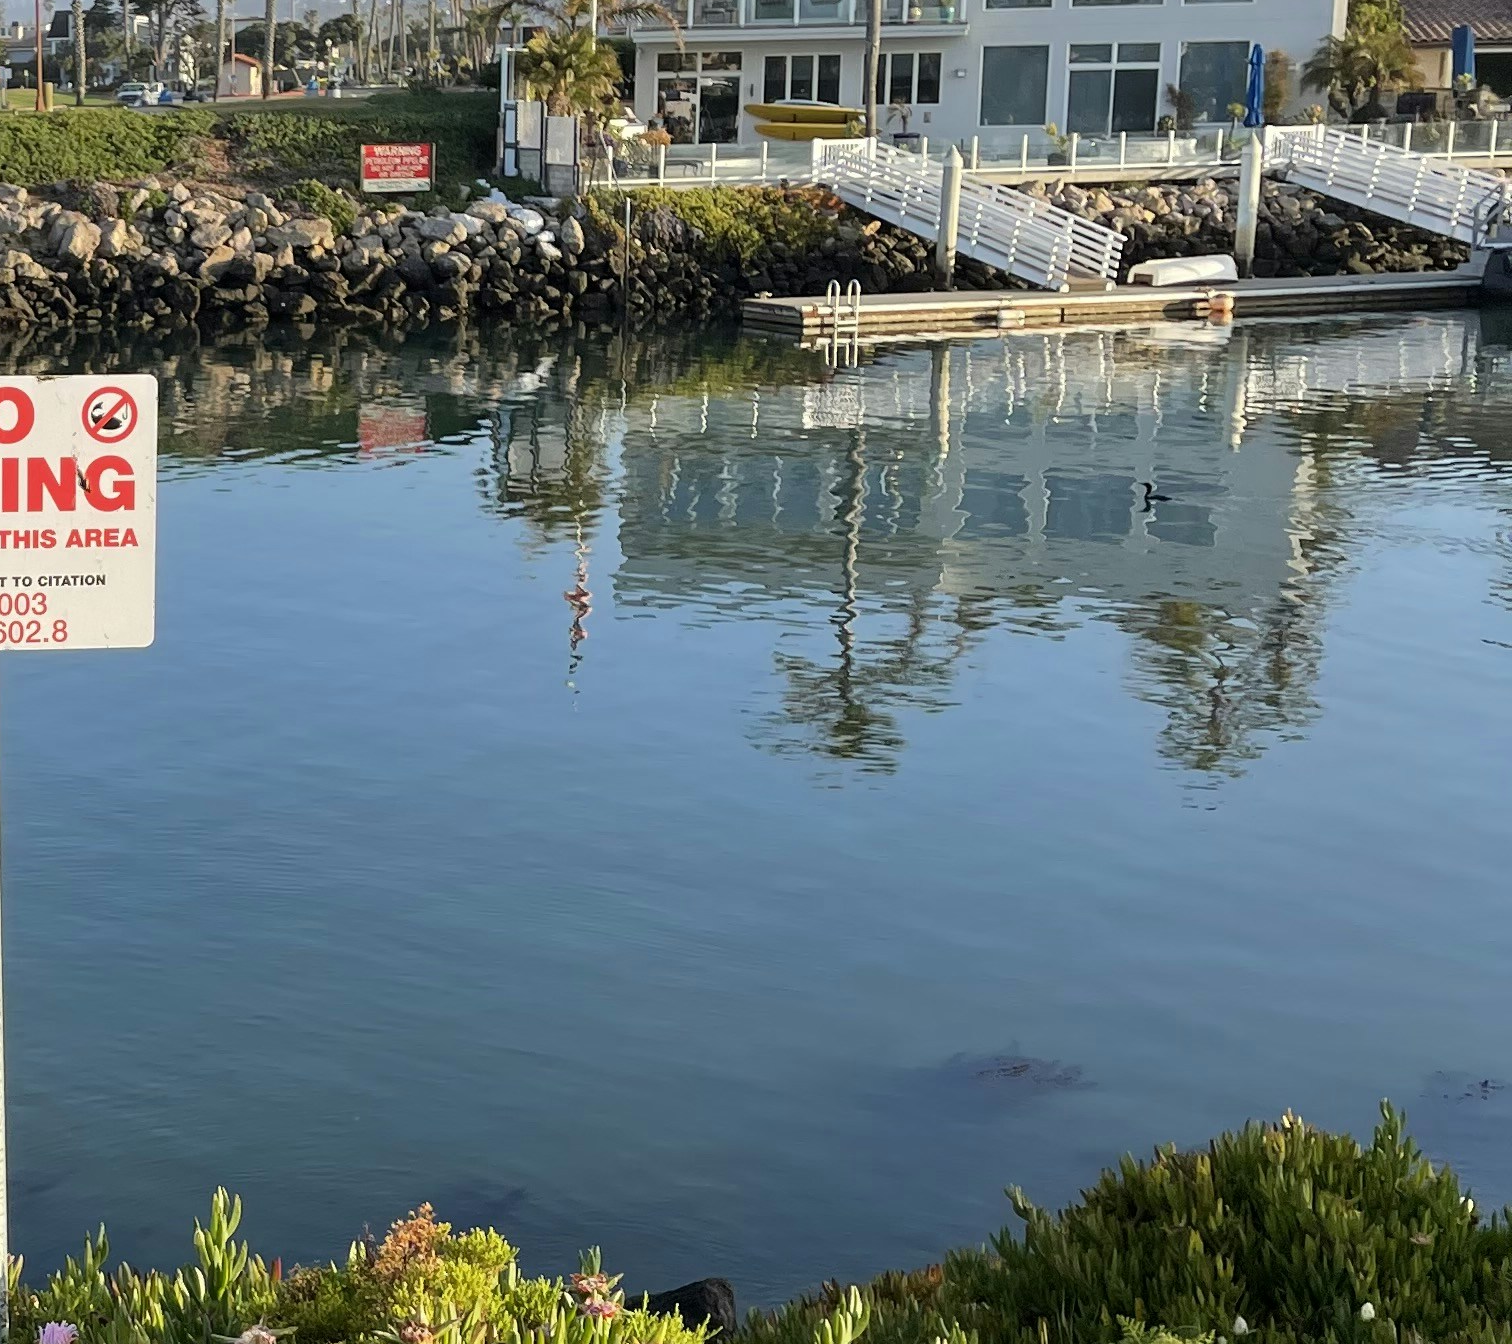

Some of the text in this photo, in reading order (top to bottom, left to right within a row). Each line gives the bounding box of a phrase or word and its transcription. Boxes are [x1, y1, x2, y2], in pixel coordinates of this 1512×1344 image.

[65, 528, 139, 547] AREA
[13, 576, 33, 587] TO
[37, 574, 106, 587] CITATION
